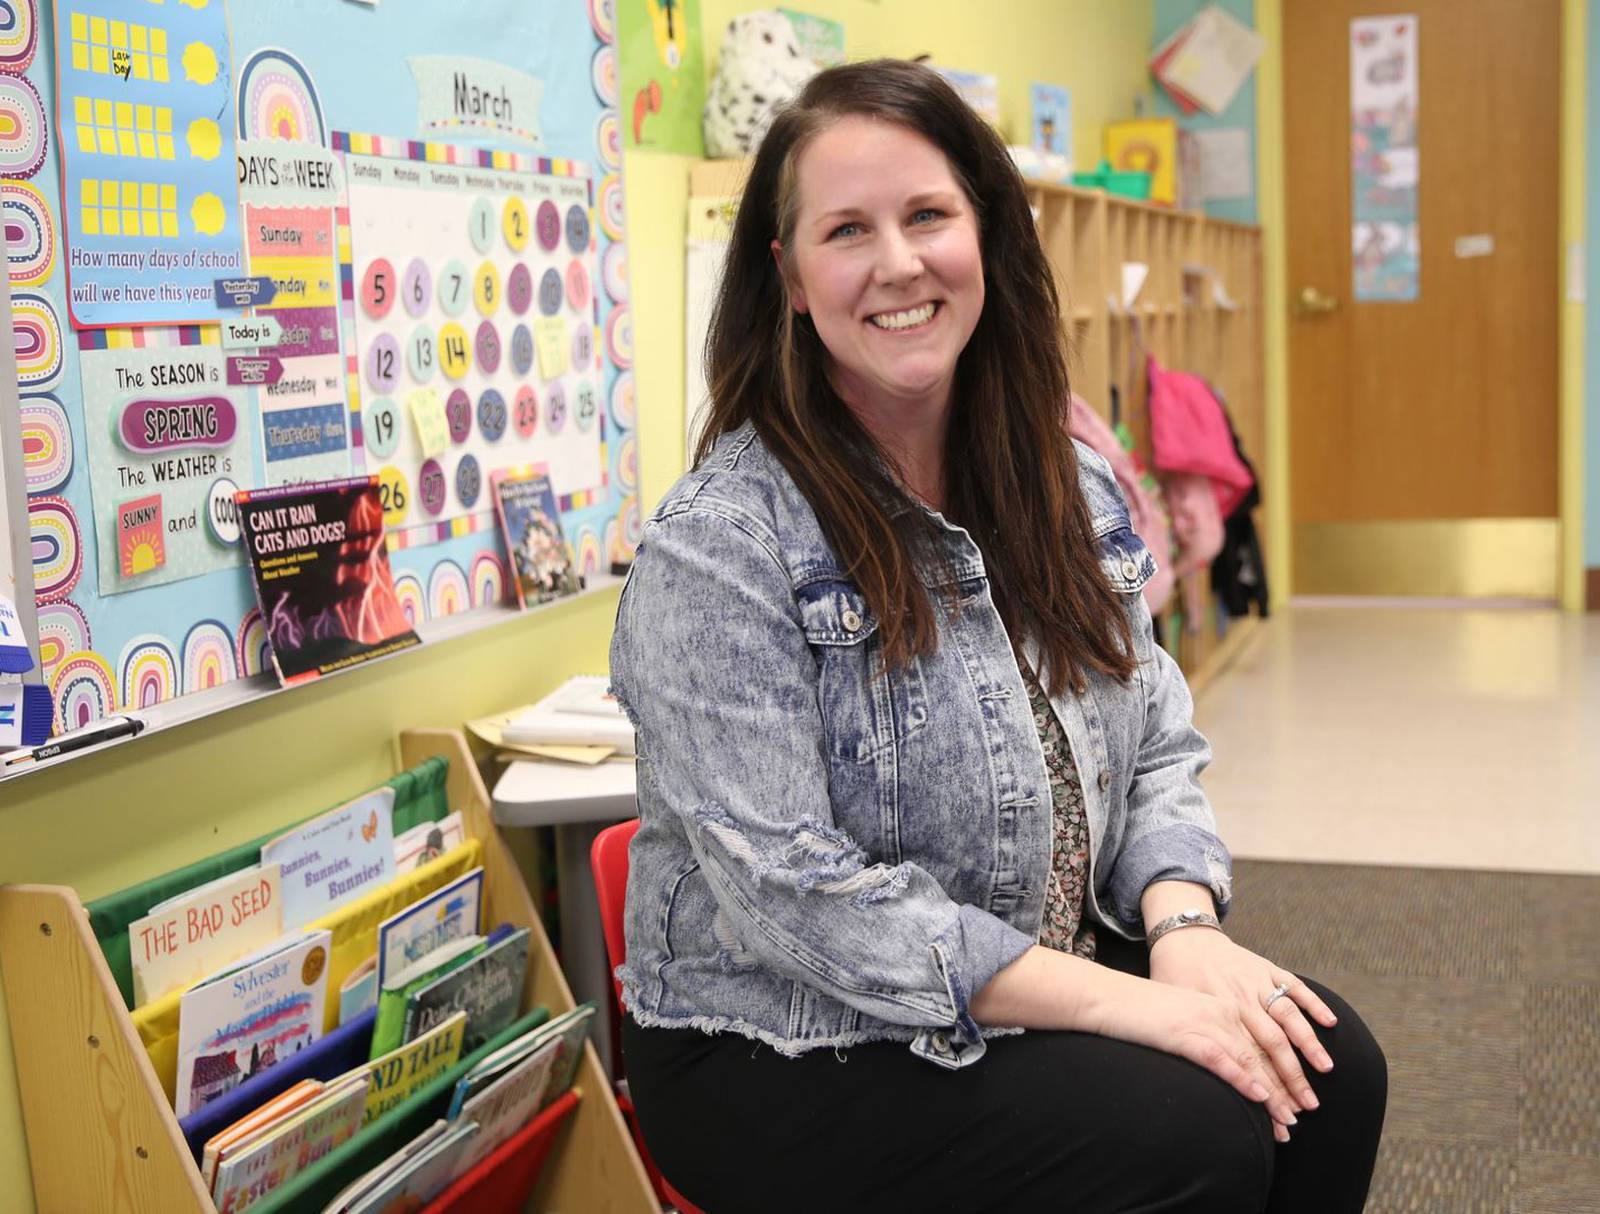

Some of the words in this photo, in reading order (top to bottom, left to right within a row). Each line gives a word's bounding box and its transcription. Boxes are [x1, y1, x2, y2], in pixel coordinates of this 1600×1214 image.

[113, 62, 131, 82] Day
[453, 72, 513, 120] March
[238, 156, 279, 186] DAYS
[293, 160, 336, 190] WEEK
[353, 163, 382, 182] Sunday
[260, 225, 303, 245] Sunday
[512, 212, 523, 238] 2
[71, 249, 102, 268] How
[107, 251, 145, 271] many
[150, 250, 179, 271] days
[183, 250, 196, 268] of
[199, 251, 239, 268] school
[73, 284, 97, 302] will
[101, 289, 121, 302] we
[125, 284, 156, 301] have
[160, 285, 182, 301] this
[186, 286, 213, 304] year
[373, 275, 385, 303] 5
[413, 275, 423, 302] 6
[451, 275, 462, 302] 7
[484, 276, 493, 302] 8
[229, 325, 260, 342] Today
[262, 324, 271, 337] is
[280, 325, 310, 347] esday
[377, 350, 394, 379] 12
[416, 338, 432, 369] 13
[445, 337, 466, 366] 14
[116, 368, 144, 389] The
[151, 364, 205, 386] SEASON
[210, 366, 219, 382] is
[266, 377, 317, 396] Wednesday
[145, 405, 218, 443] SPRING
[270, 424, 321, 446] Thursday
[374, 410, 394, 446] 19
[482, 402, 506, 426] 22
[519, 398, 537, 428] 23
[117, 467, 146, 488] The
[152, 455, 217, 482] WEATHER
[222, 457, 232, 473] is
[380, 482, 406, 512] 26
[123, 505, 158, 530] SUNNY
[167, 510, 198, 533] and
[214, 496, 241, 524] COO
[250, 510, 276, 533] CAN
[275, 508, 288, 527] IT
[288, 504, 318, 526] RAIN
[254, 531, 285, 554] CATS
[286, 527, 310, 549] AND
[310, 520, 346, 545] DOGS?
[304, 856, 352, 888] Bunnies,
[328, 857, 385, 900] Bunnies!
[140, 921, 179, 962] THE
[186, 903, 224, 944] BAD
[231, 879, 272, 928] SEED
[232, 959, 290, 999] Sylvester
[367, 1056, 403, 1093] ND
[409, 1031, 456, 1076] TALL
[222, 1162, 290, 1214] Easter
